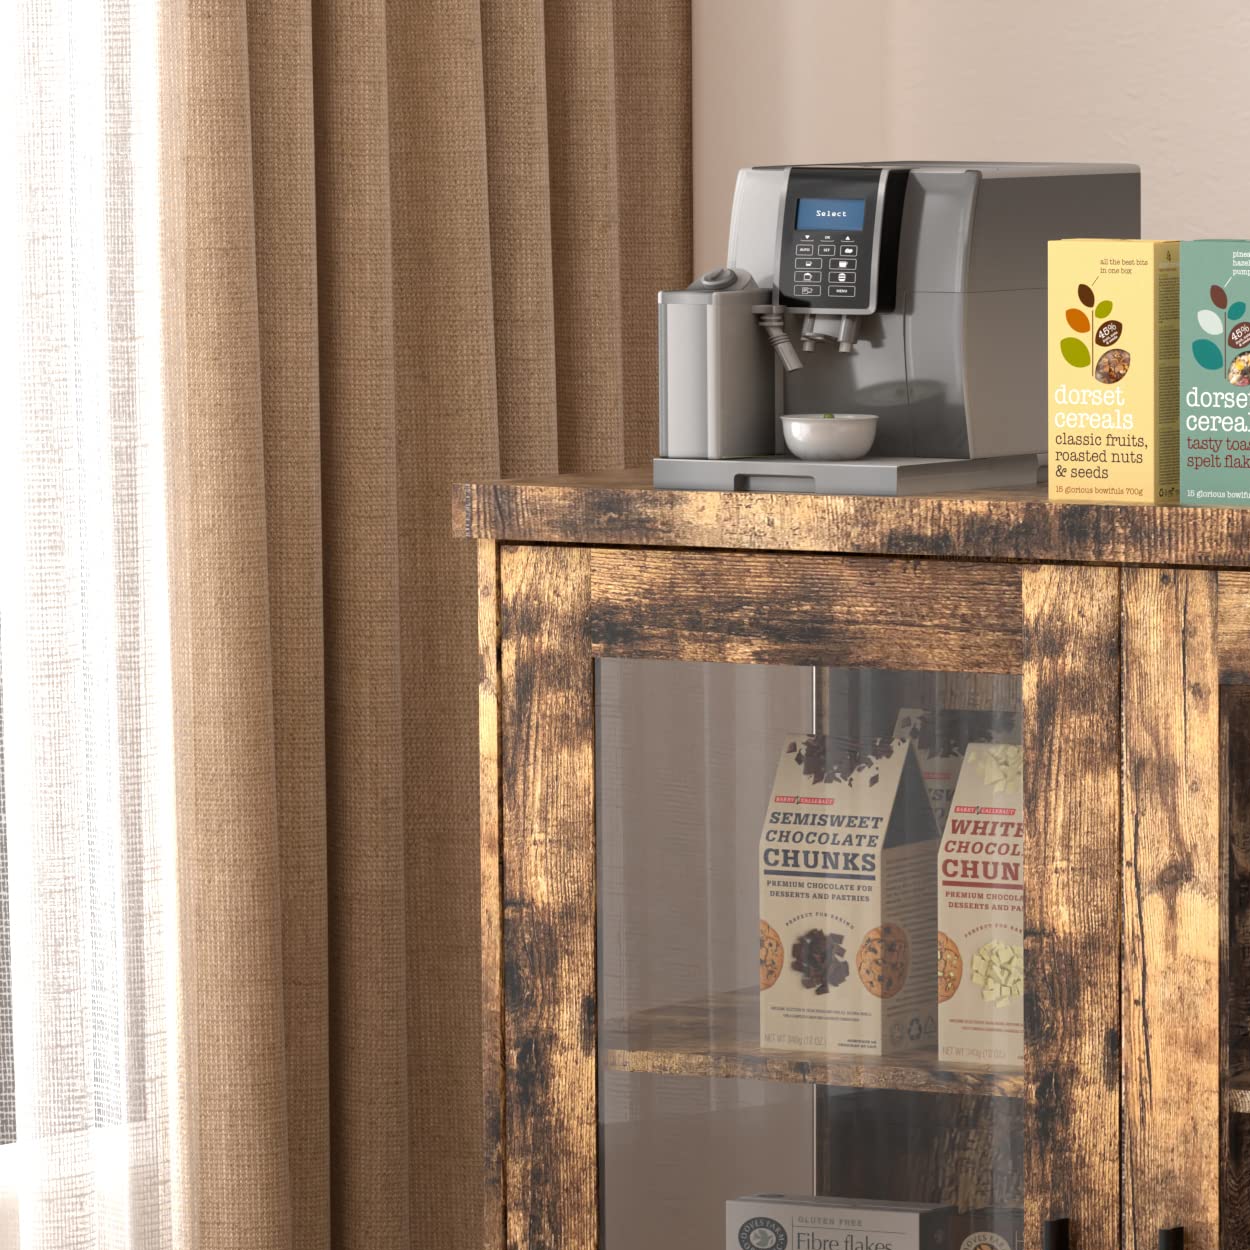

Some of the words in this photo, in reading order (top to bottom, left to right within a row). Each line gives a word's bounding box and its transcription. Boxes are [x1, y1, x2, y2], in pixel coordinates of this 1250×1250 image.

[1100, 258, 1108, 266] all
[1110, 258, 1120, 266] the
[1122, 258, 1134, 266] best
[1231, 323, 1250, 341] 45%
[1054, 384, 1125, 406] dorset
[1054, 409, 1134, 430] cereals
[1055, 432, 1102, 446] classic
[1105, 433, 1148, 449] fruits,
[1187, 436, 1223, 453] tasty
[1055, 450, 1107, 463] roasted
[1111, 451, 1143, 464] nuts
[1187, 454, 1222, 470] spelt
[1055, 464, 1067, 478] &
[1070, 466, 1109, 479] seeds
[1056, 485, 1064, 493] 15
[1065, 486, 1094, 495] glorious
[1095, 486, 1125, 495] bowlfuls
[1126, 487, 1144, 496] 700g
[1196, 490, 1226, 499] glorious
[769, 811, 884, 829] SEMISWEET
[765, 829, 879, 848] CHOCOLATE
[944, 840, 1023, 856] CHOCOL
[763, 848, 876, 872] CHUNKS
[942, 859, 1022, 881] CHUN
[767, 880, 804, 889] PREMIUM
[807, 882, 855, 891] CHOCOLATE
[769, 890, 810, 899] DESSERTS
[831, 894, 870, 902] PASTRIES
[945, 891, 984, 900] PREMIUM
[986, 893, 1023, 901] CHOCOLA
[948, 902, 989, 910] DESSERTS
[991, 903, 1009, 911] AND
[798, 1215, 835, 1225] GLUTEN
[839, 1218, 863, 1227] FREE
